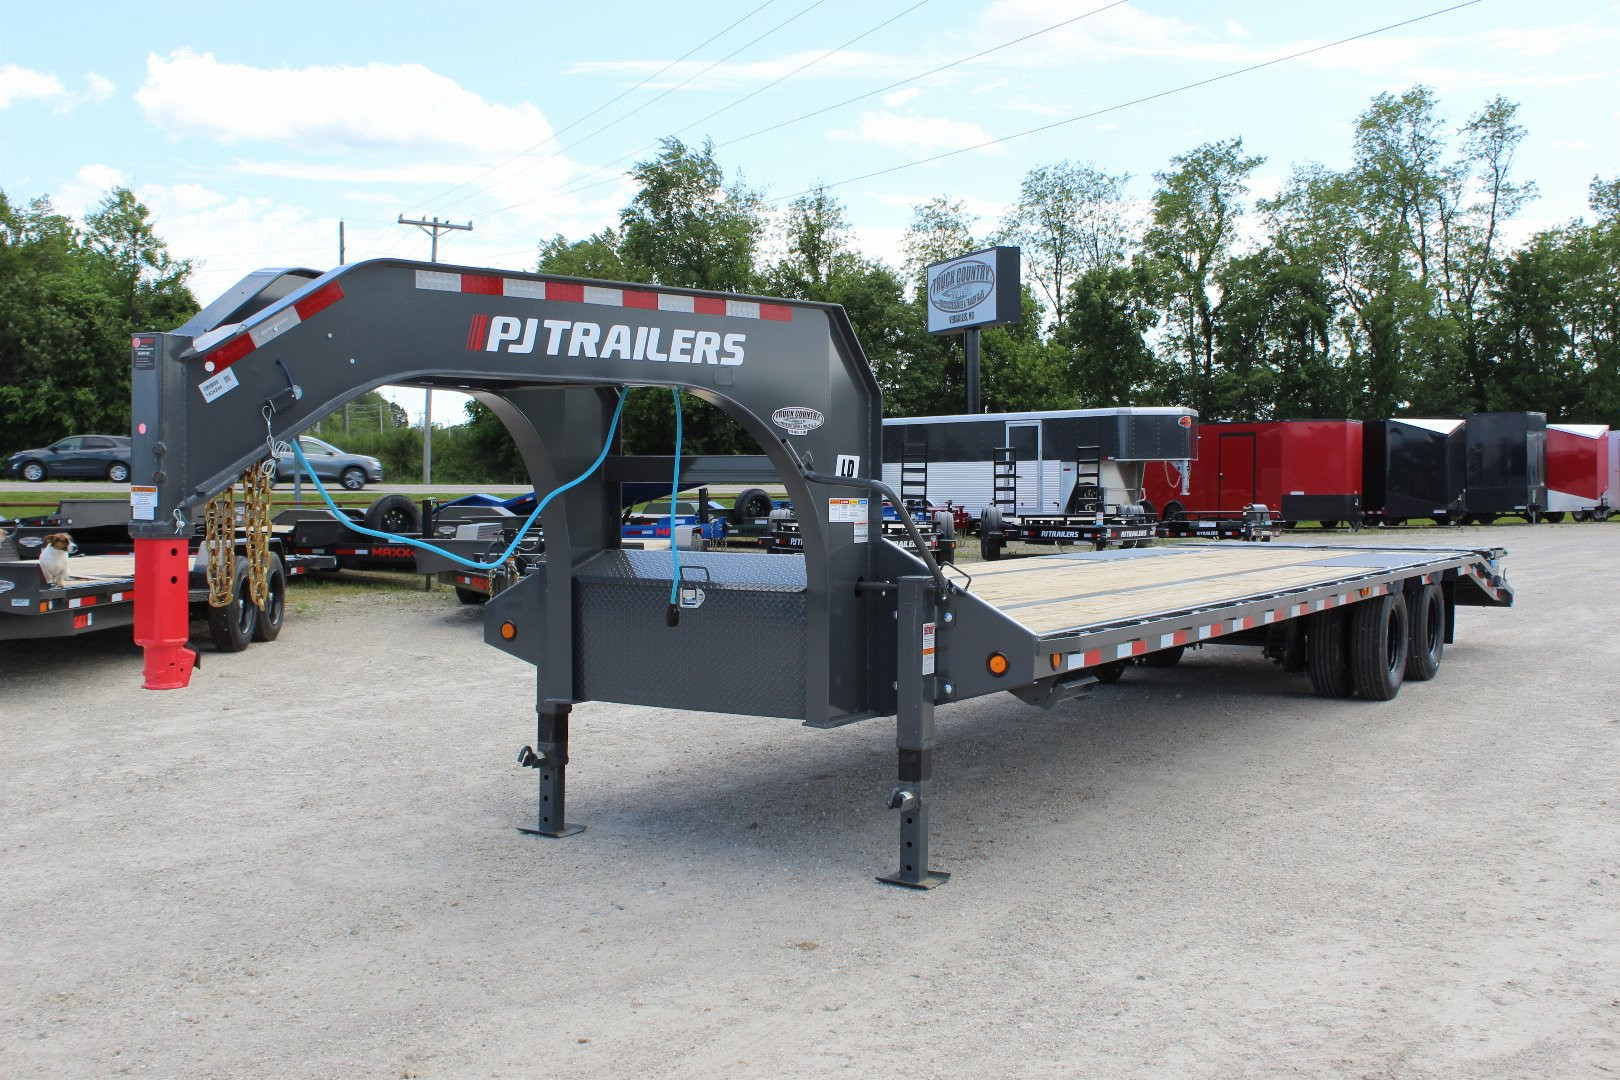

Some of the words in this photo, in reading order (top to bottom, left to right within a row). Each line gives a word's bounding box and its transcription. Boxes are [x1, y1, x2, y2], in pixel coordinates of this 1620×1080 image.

[932, 273, 955, 294] TRUCK
[957, 264, 991, 283] COUNTRY
[485, 315, 538, 354] PJ
[543, 319, 746, 366] TRAILERS
